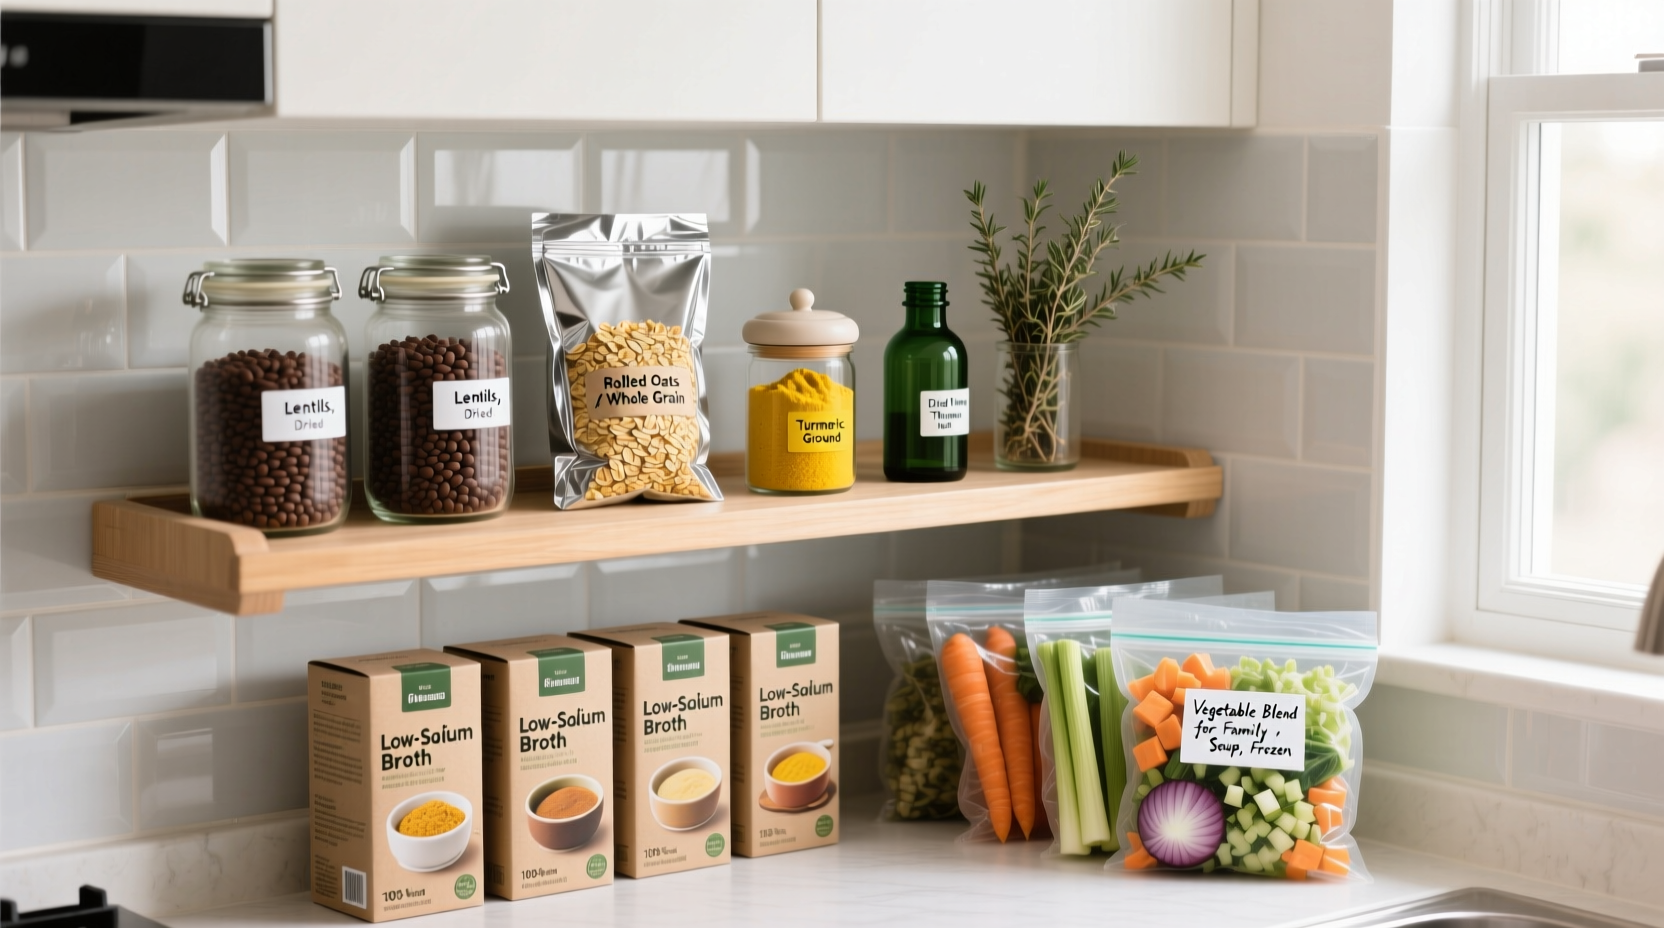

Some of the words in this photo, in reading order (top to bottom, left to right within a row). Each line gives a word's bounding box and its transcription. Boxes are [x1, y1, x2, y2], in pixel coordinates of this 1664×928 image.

[604, 374, 646, 389] Rolled
[651, 374, 680, 387] Oats
[455, 388, 501, 405] Lentils,
[606, 391, 649, 406] Whole
[653, 391, 685, 405] Grain
[760, 701, 800, 720] Broth
[1194, 698, 1256, 721] Vegetable
[1262, 703, 1298, 719] Blend
[643, 714, 687, 736] Broth
[1193, 720, 1217, 739] for
[520, 731, 567, 752] Broth
[381, 748, 432, 771] Broth
